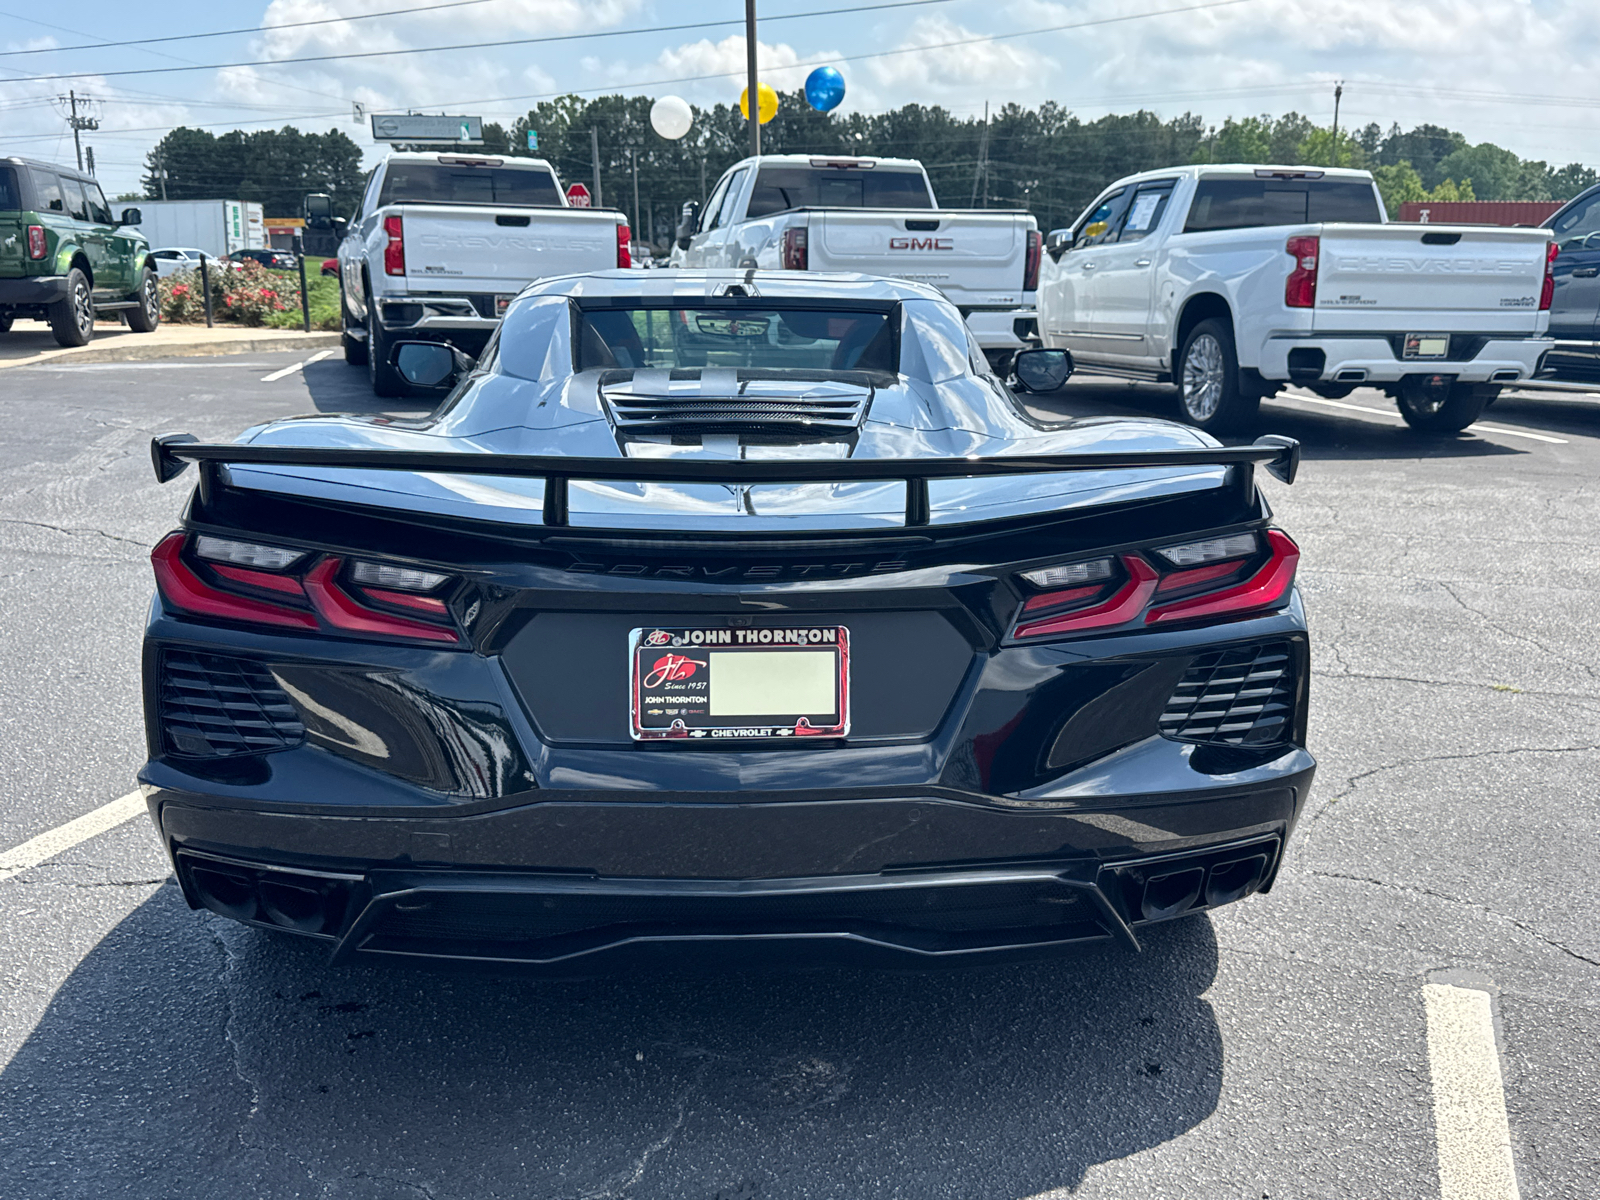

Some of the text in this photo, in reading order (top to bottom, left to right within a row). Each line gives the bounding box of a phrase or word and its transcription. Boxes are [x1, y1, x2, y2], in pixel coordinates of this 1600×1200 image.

[567, 195, 590, 207] STOP
[420, 234, 604, 251] CHEVROLET
[889, 237, 954, 250] GMC
[1337, 257, 1534, 274] CHEVROLET
[565, 560, 907, 577] CORVETTE
[682, 628, 836, 644] JOHN THORNTON
[664, 682, 707, 690] Since 1957
[645, 696, 707, 704] JOHN THORNTON
[711, 729, 773, 738] CHEVROLET
